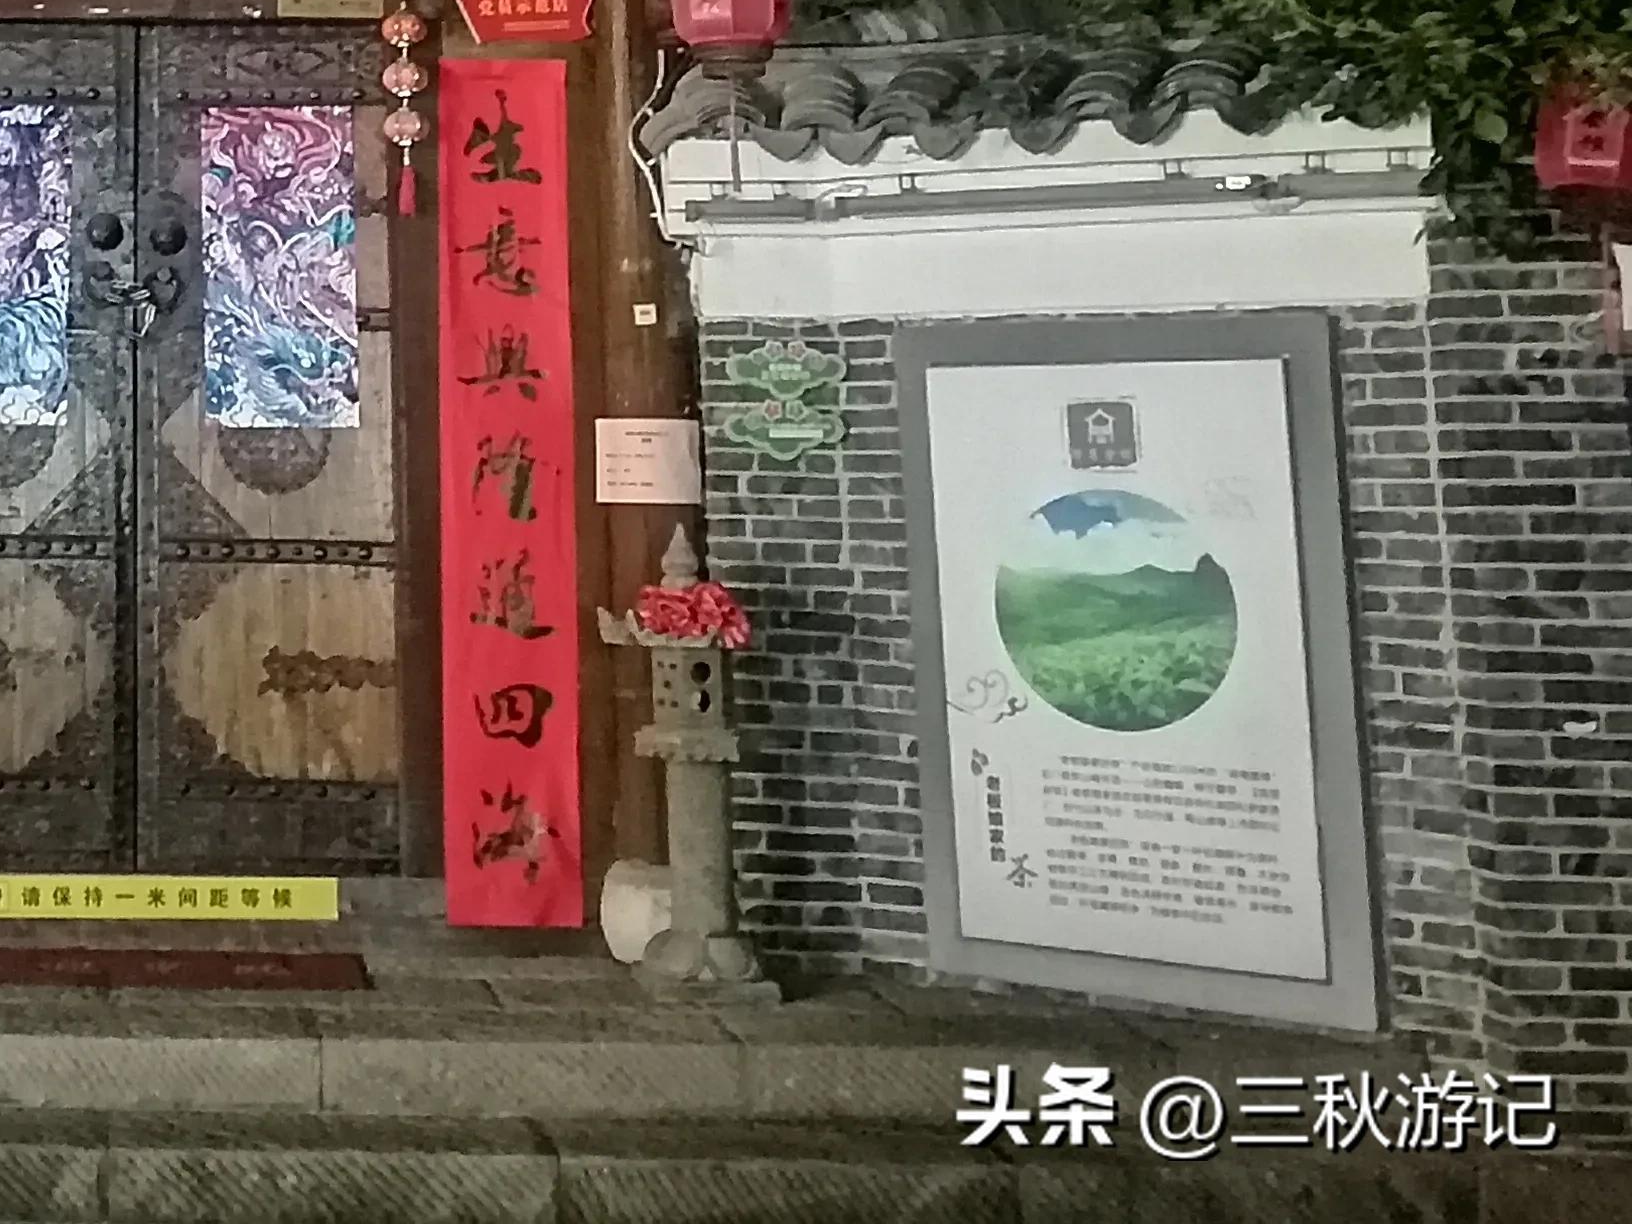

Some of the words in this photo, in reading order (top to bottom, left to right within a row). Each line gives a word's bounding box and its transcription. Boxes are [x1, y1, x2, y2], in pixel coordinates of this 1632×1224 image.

[21, 885, 293, 908] 请保持一米间距等候
